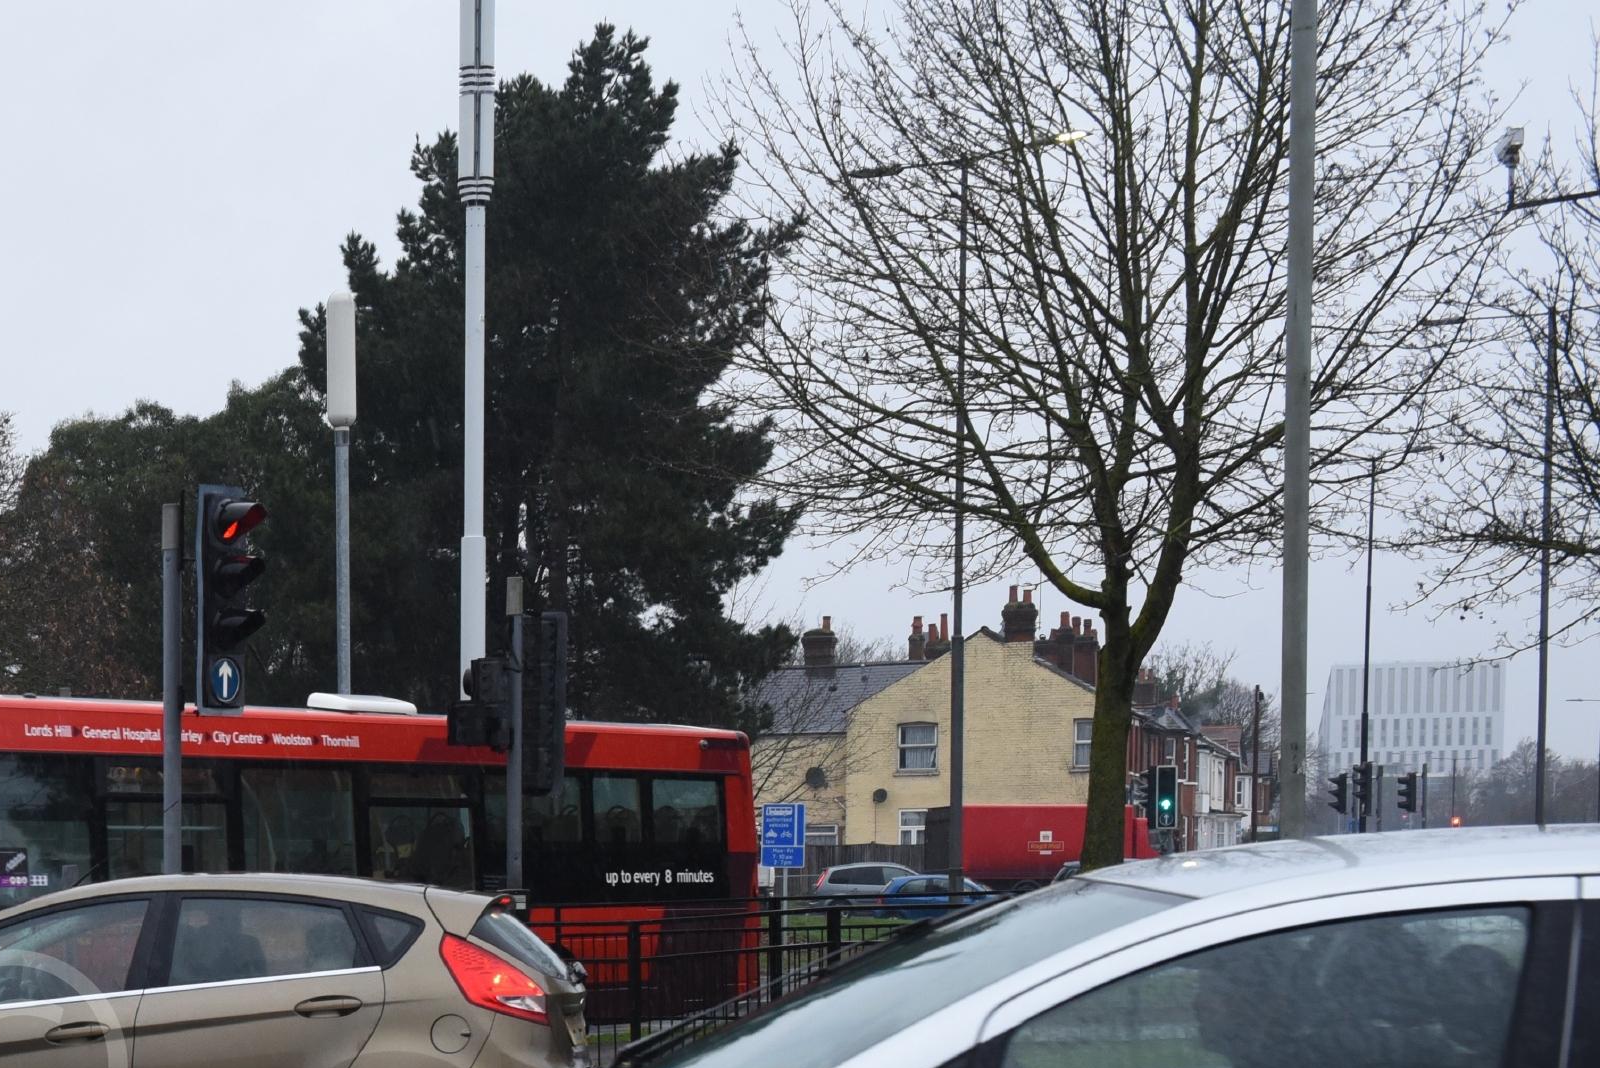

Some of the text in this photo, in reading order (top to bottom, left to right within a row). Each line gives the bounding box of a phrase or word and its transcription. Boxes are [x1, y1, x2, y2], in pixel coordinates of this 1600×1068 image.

[24, 723, 361, 748] Lords Hill General Hospital irley City Centre Woolston Thornhill
[605, 868, 714, 887] up to every 8 minutes
